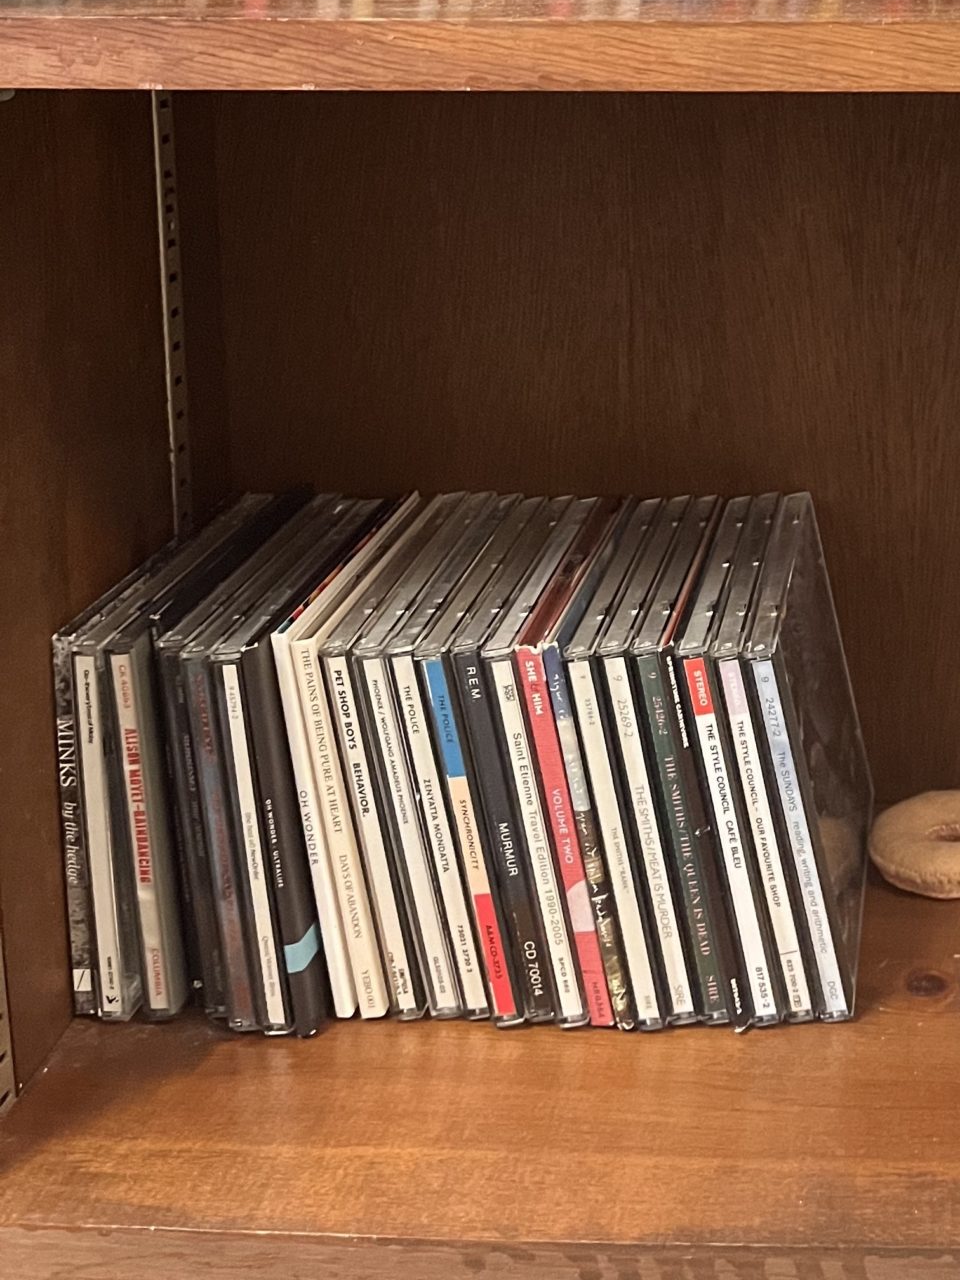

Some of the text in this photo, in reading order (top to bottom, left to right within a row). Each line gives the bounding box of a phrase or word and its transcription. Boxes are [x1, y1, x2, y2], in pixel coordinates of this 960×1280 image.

[334, 670, 370, 817] PET SHOP BOYS BEHAVIOR.
[372, 679, 408, 824] PHOENIX WOLFGANG AMADEUS PHOENIX
[694, 670, 707, 706] STEREO
[57, 718, 80, 884] MINKS by the hedge
[299, 790, 319, 866] OH WONDER
[301, 648, 363, 939] THE PAINS OF BEING PURE AT HEART DAYS OF ABANDON
[403, 685, 450, 873] THE POLICE ZENYATTA MONDATTA
[705, 723, 741, 869] THE STYLE COUNCIL CAFÉ BLEU
[736, 720, 781, 908] THE STYLE COUNCIL OUR FAVOURITE SHOP
[524, 941, 543, 996] CD 70014
